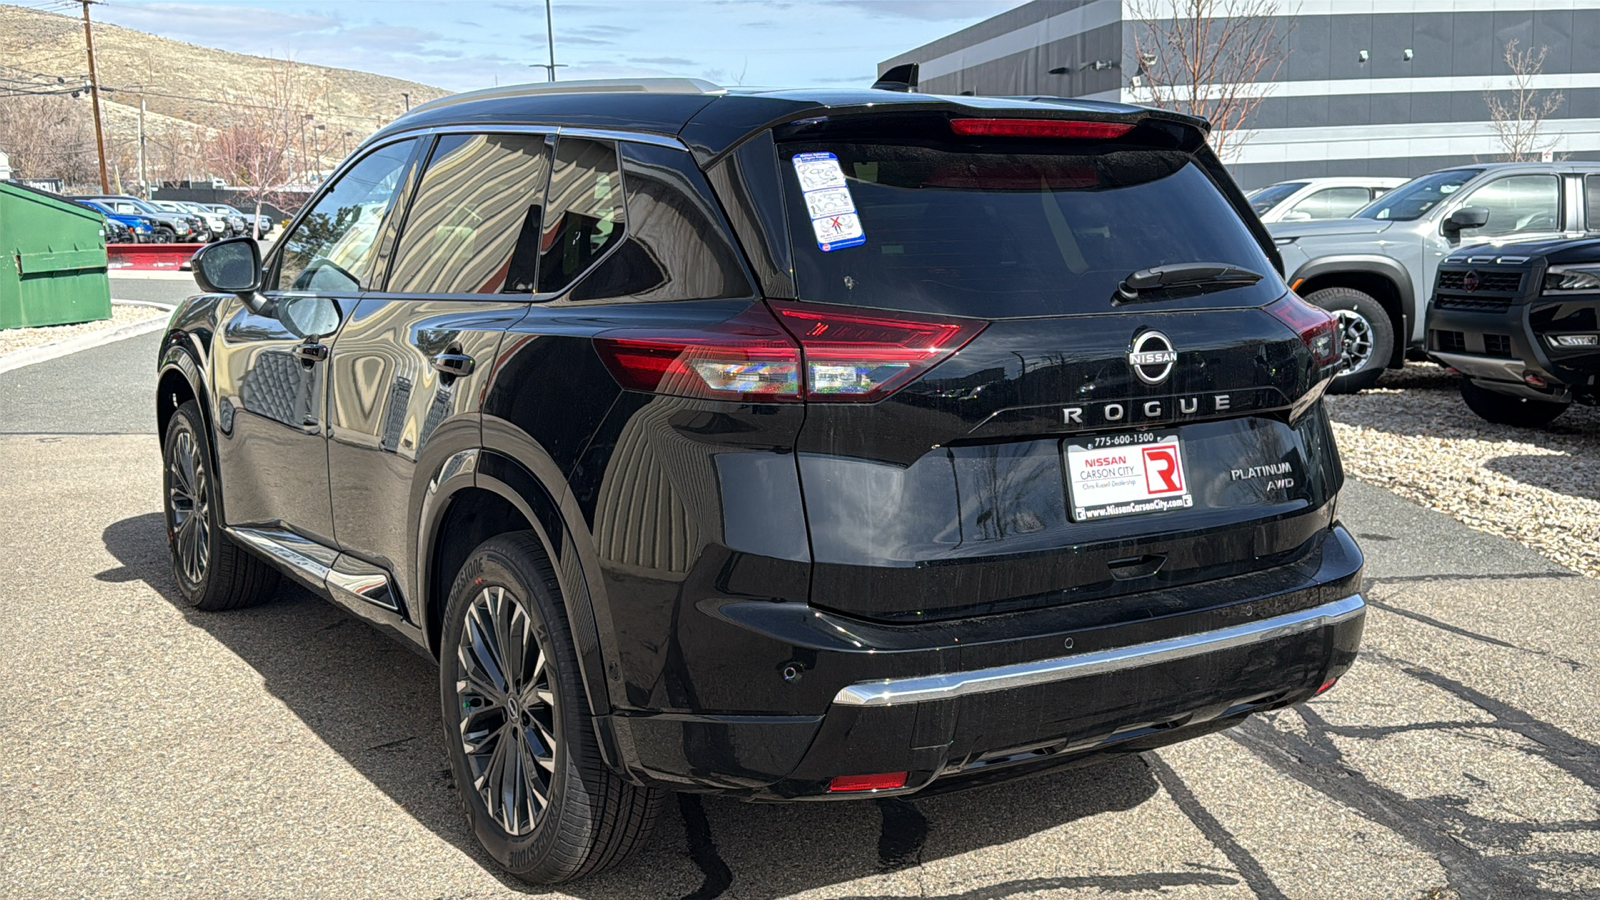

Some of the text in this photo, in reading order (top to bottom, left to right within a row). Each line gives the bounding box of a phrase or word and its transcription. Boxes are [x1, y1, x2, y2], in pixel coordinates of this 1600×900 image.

[1131, 352, 1178, 364] NISSAN
[1063, 395, 1231, 424] ROGUE
[1095, 433, 1154, 446] 775-600-1500
[1085, 456, 1126, 467] NISSAN
[1080, 466, 1134, 480] CARSON CITY
[1231, 462, 1292, 481] PLATINUM
[1267, 478, 1294, 491] AWD
[1086, 499, 1183, 517] www.NissanCarsonCity.com
